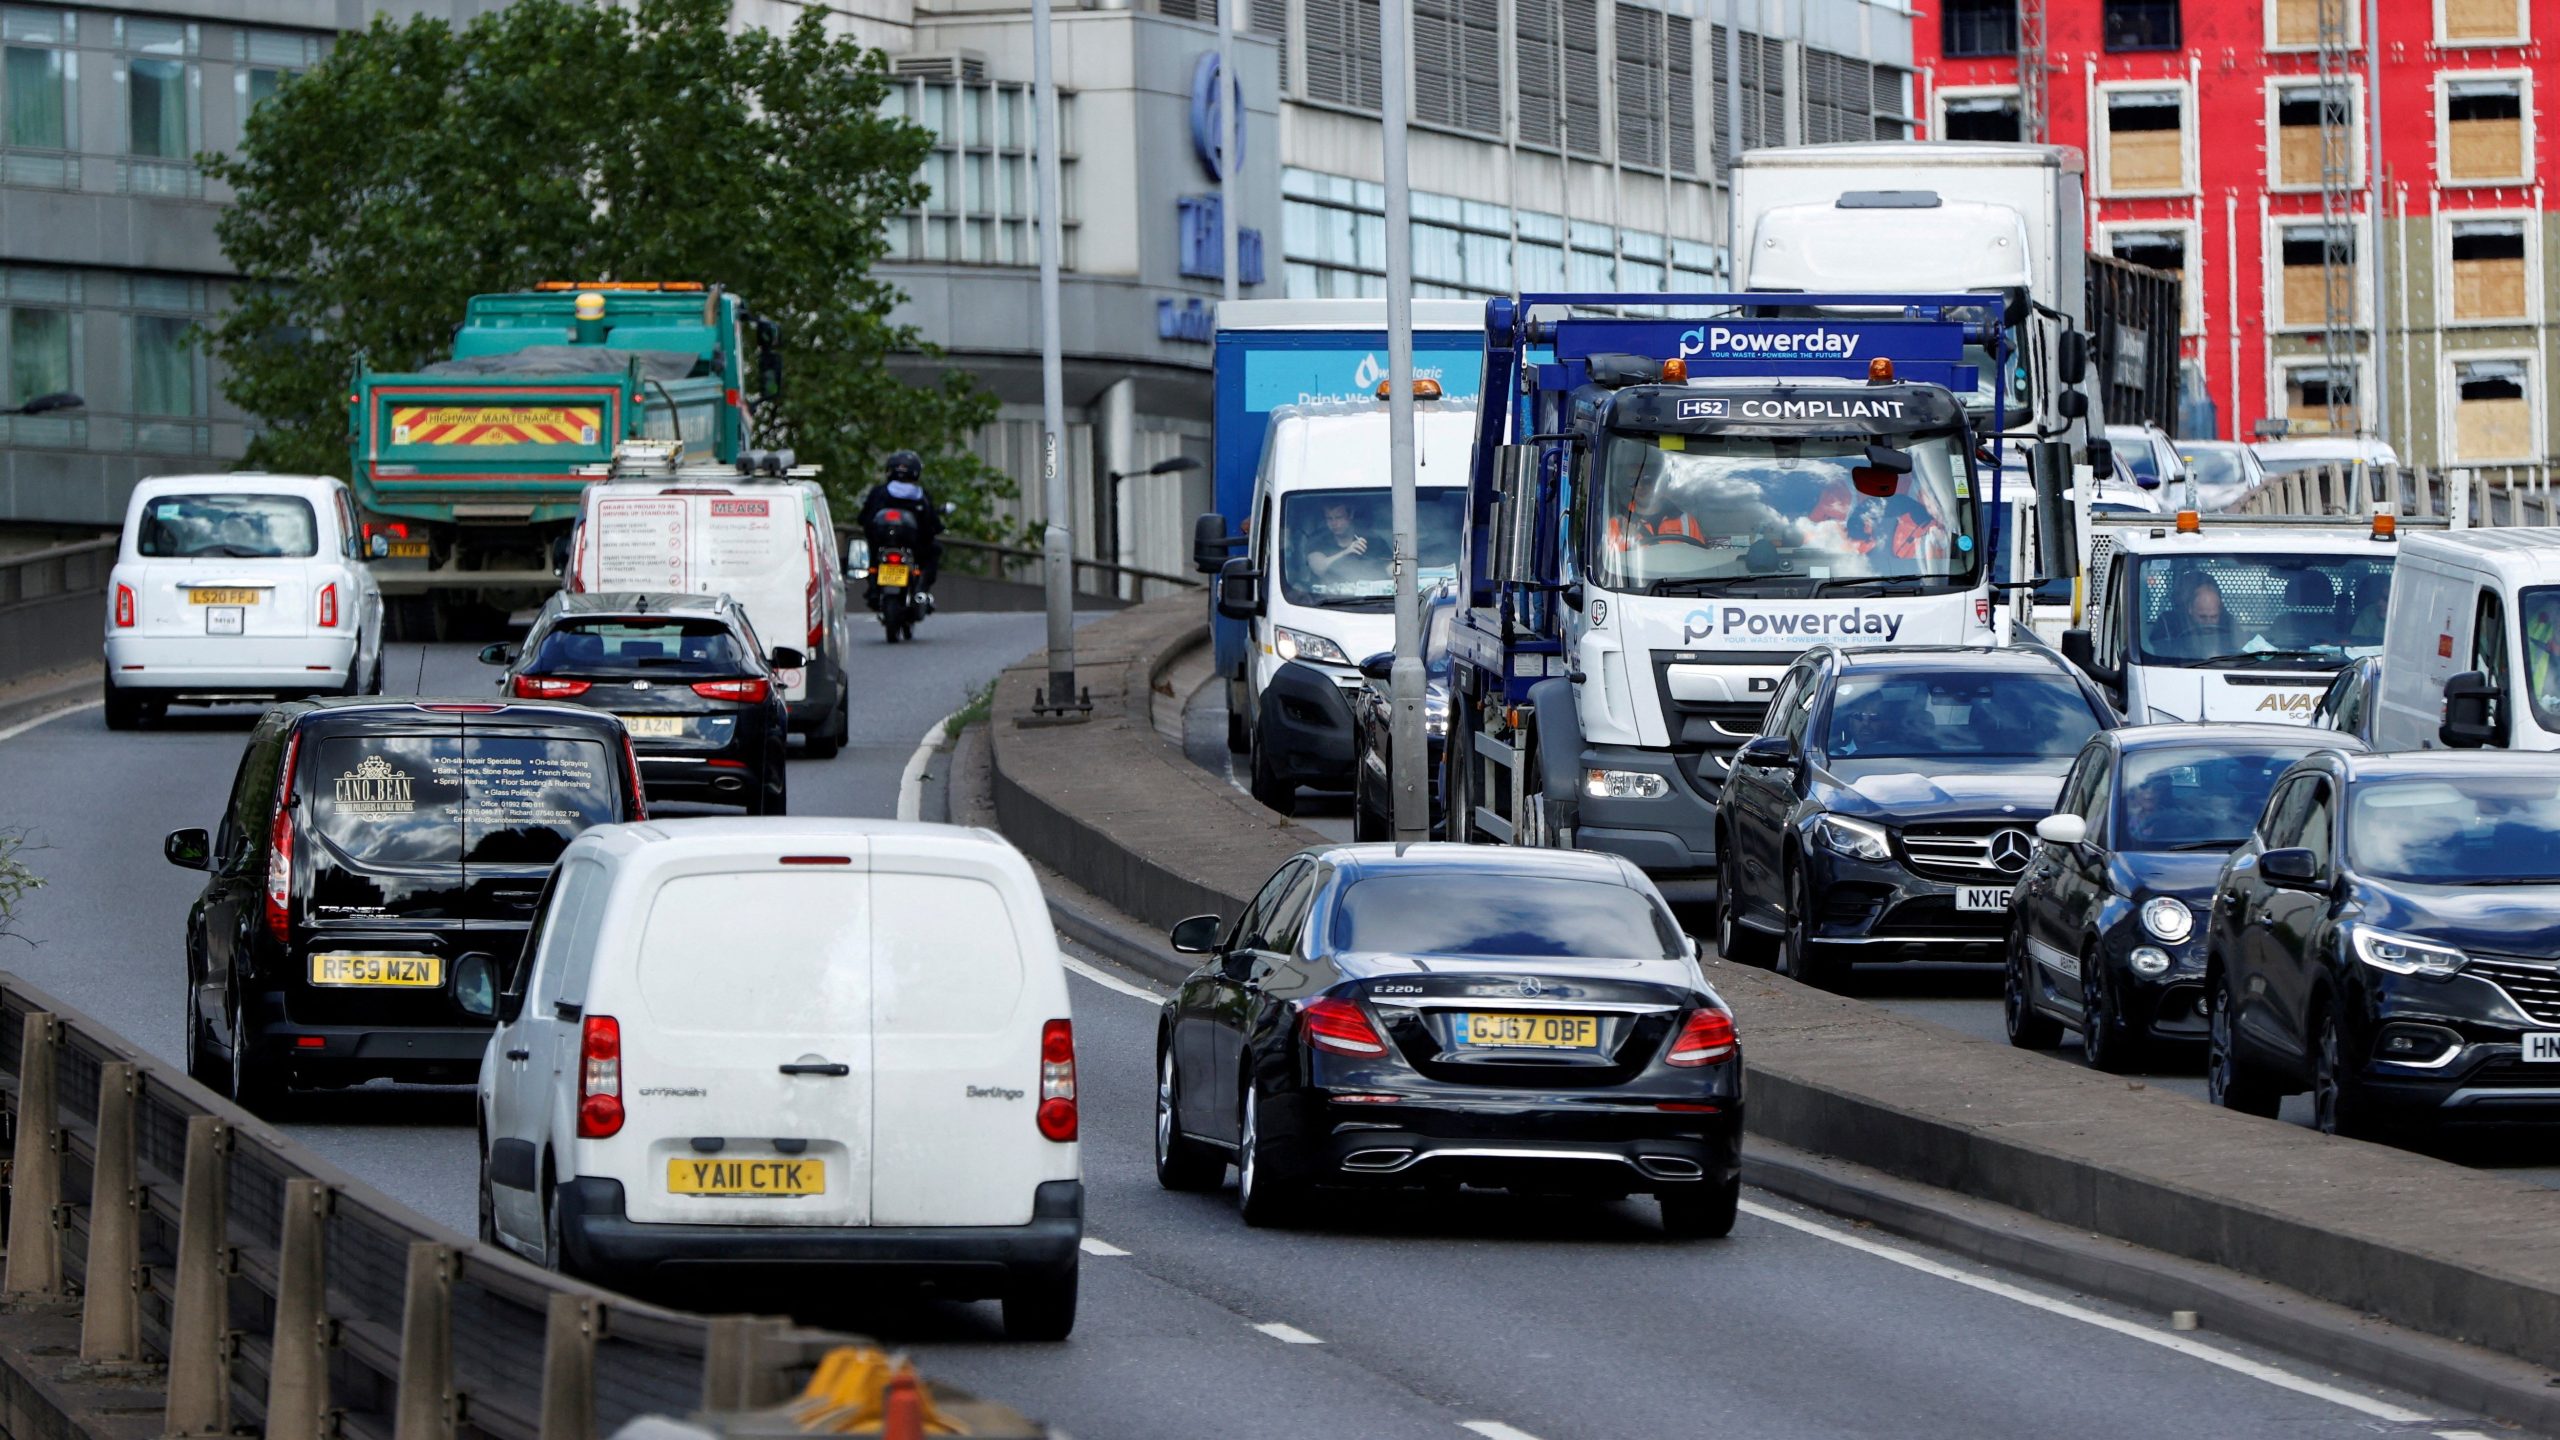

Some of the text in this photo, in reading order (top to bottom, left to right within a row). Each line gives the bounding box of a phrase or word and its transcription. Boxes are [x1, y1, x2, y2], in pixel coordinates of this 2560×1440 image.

[1710, 327, 1860, 358] Powerday
[1378, 366, 1443, 379] wlogic
[1683, 400, 1905, 418] HS2 COMPLIANT
[429, 414, 562, 425] HIGHWAY MAINTENANCE
[714, 503, 766, 513] MEARS
[193, 590, 255, 603] LS20 FFJ
[1723, 607, 1903, 642] Powerday
[644, 720, 672, 733] AZN
[487, 757, 521, 765] Specialists
[560, 760, 588, 768] Spraying
[562, 770, 592, 779] Polishing
[336, 779, 370, 801] CANO
[377, 779, 411, 801] BEAN
[520, 780, 547, 788] Sanding
[555, 781, 591, 789] Refinishing
[511, 790, 541, 798] Polishing
[1968, 890, 2011, 907] NX16
[319, 905, 386, 913] TRANSIT
[323, 959, 430, 981] RF69 MZN
[1374, 985, 1423, 994] E 220d
[1473, 1017, 1591, 1042] GJ67 OBF
[966, 1085, 1024, 1101] Berlingo
[750, 1163, 803, 1189] CTK
